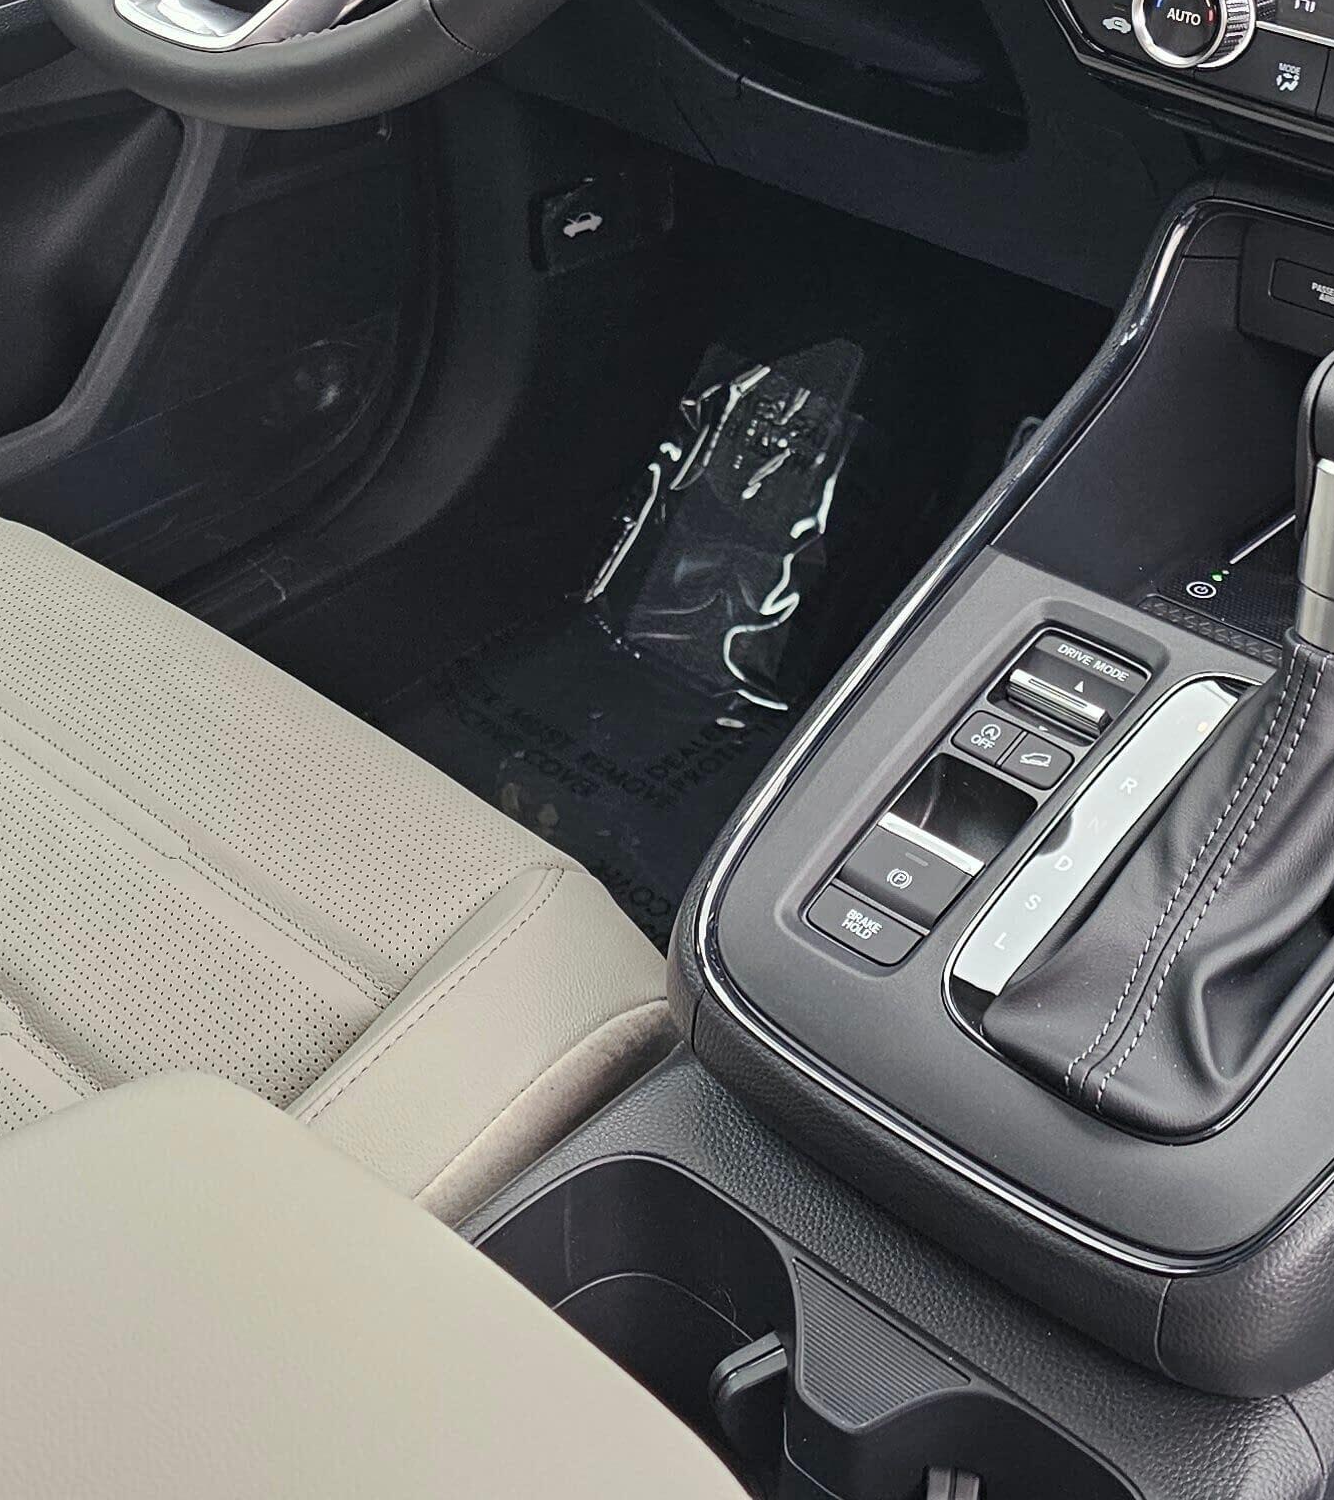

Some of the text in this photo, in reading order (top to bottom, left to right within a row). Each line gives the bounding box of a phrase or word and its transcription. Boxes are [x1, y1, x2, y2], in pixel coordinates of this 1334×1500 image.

[1166, 7, 1201, 26] AUTO
[1278, 62, 1301, 74] MODE
[1057, 642, 1129, 682] DRIVE MODE
[970, 734, 996, 750] OFF
[1119, 777, 1139, 795] R
[1054, 855, 1073, 872] D
[1024, 894, 1042, 910] S
[841, 918, 874, 940] HOLD
[846, 908, 882, 935] BRAKE
[993, 932, 1007, 949] L
